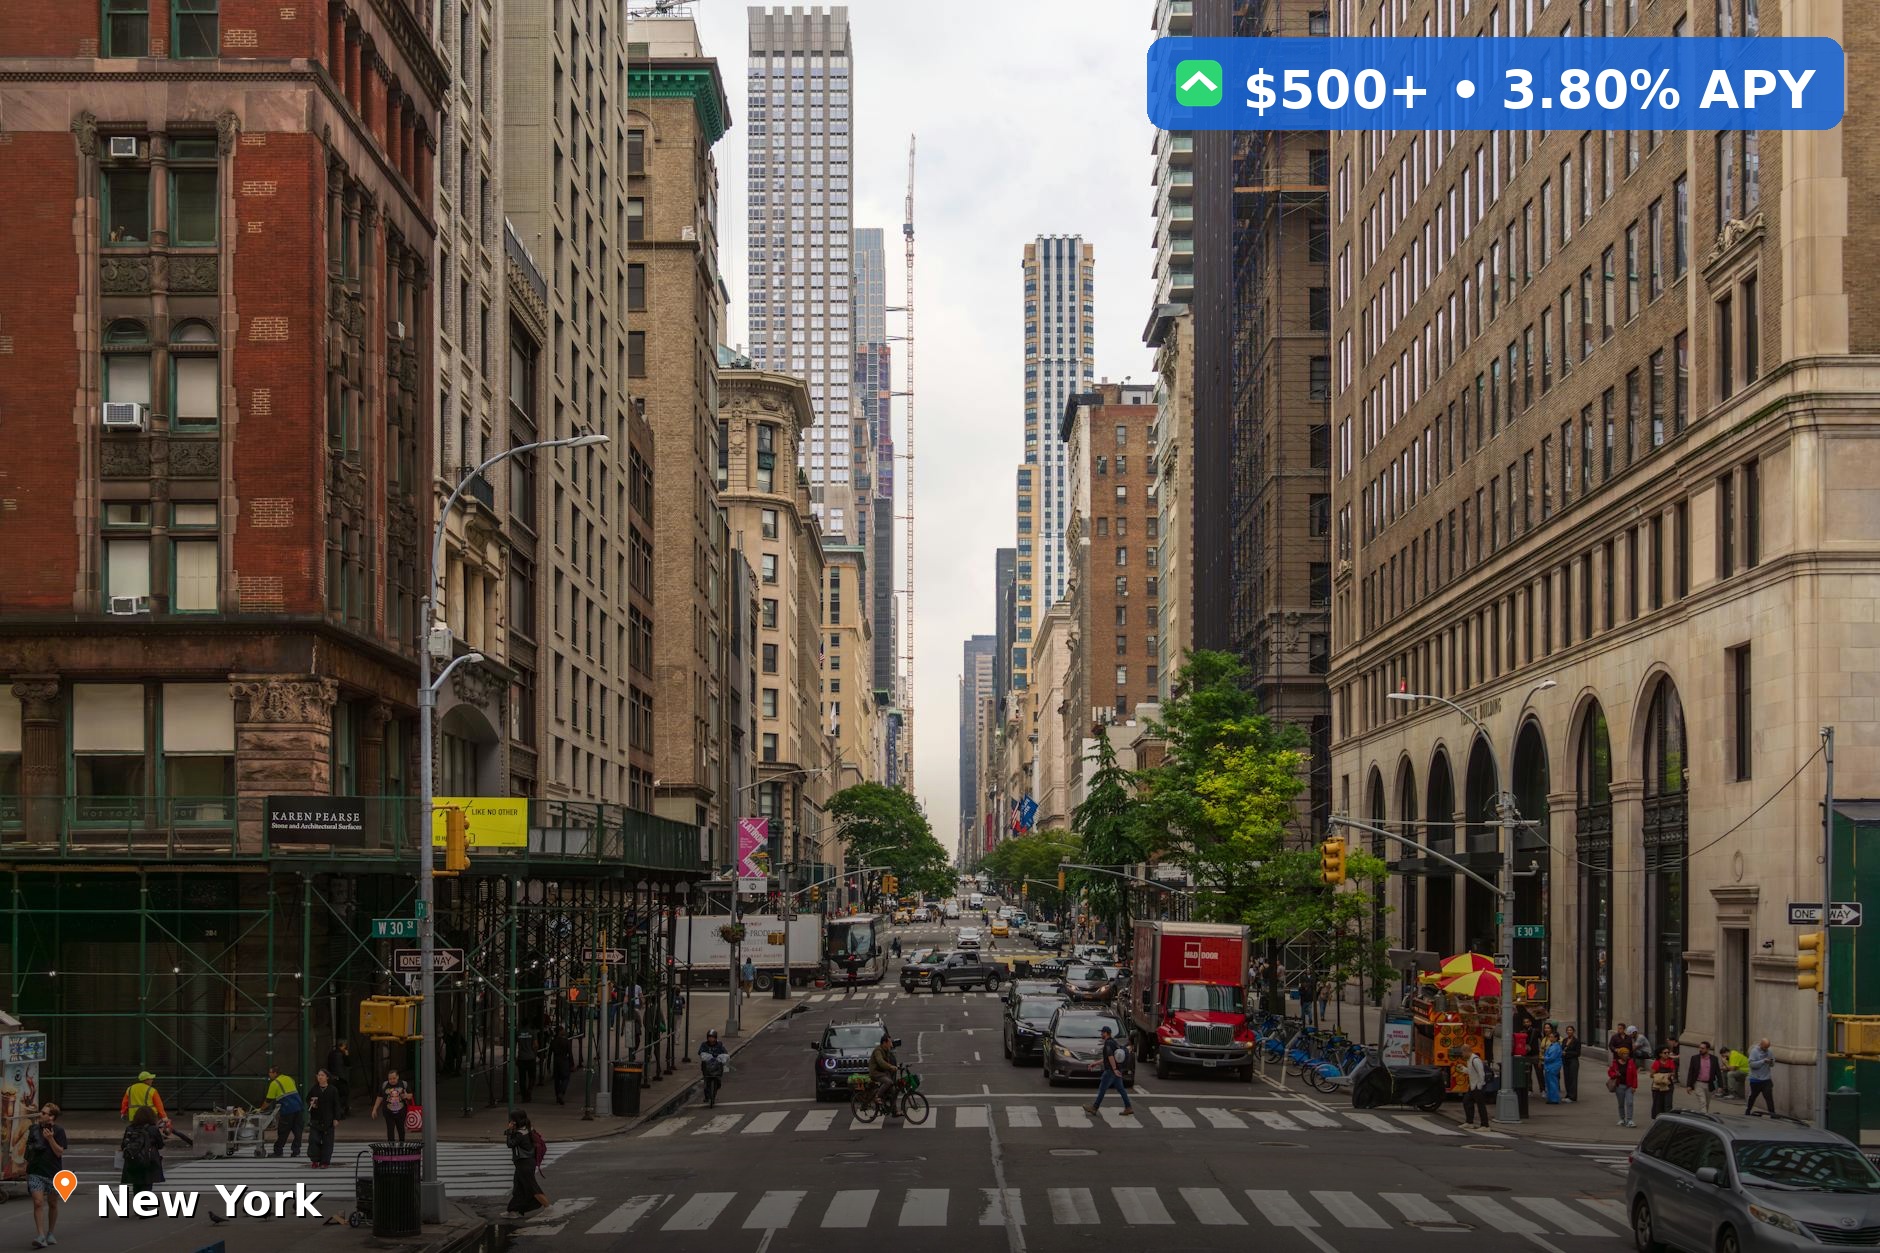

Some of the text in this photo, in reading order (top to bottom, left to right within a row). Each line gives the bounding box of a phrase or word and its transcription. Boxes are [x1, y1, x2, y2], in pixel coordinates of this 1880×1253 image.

[471, 808, 485, 816] LIKE
[487, 808, 496, 816] NO
[498, 808, 518, 816] OTHER
[272, 812, 360, 822] KAREN PEARSE
[301, 823, 338, 831] Architectural
[338, 823, 362, 831] Surfaces
[1794, 909, 1852, 919] ONE WAY
[378, 921, 387, 935] W
[390, 921, 404, 935] 30
[1517, 927, 1523, 936] E
[1523, 927, 1533, 936] 30
[1201, 952, 1219, 960] DOOR
[402, 956, 452, 966] ONE WAY
